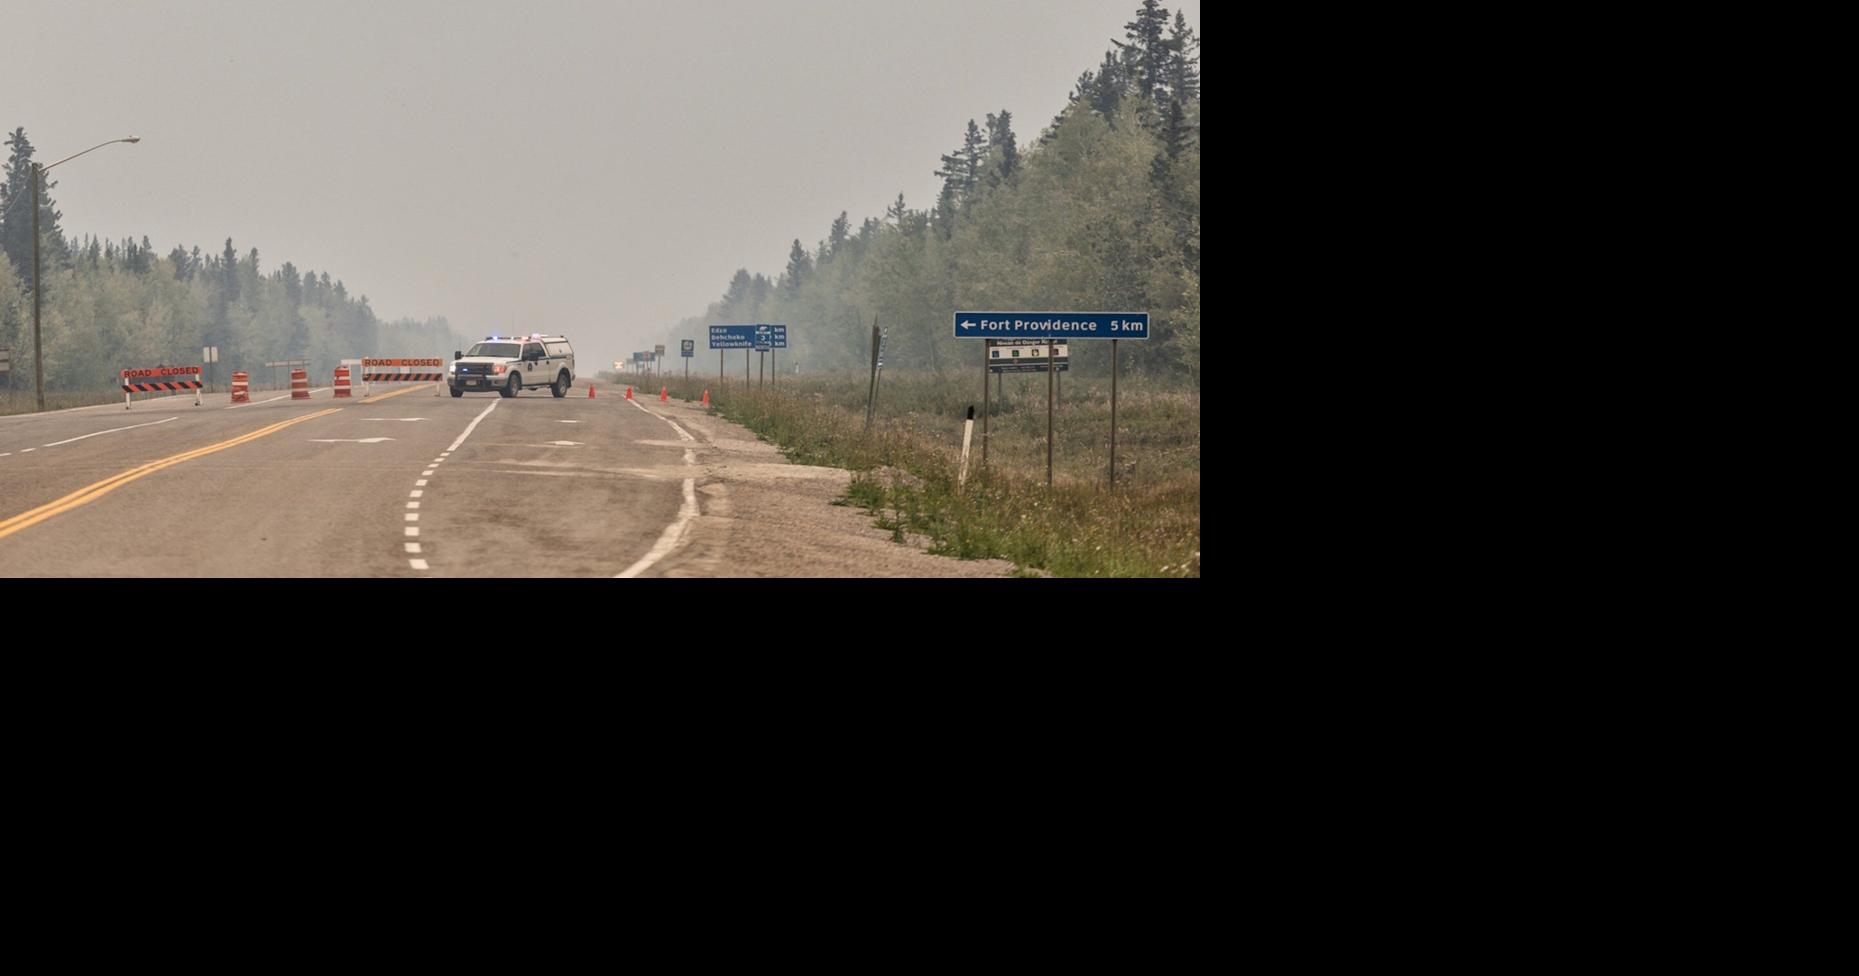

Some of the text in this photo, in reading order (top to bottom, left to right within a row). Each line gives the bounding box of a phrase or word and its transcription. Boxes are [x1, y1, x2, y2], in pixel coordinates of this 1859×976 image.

[980, 318, 1143, 331] Fort Providence 5 km
[364, 359, 440, 367] ROAD CLOSED
[124, 366, 199, 378] ROAD CLOSED
